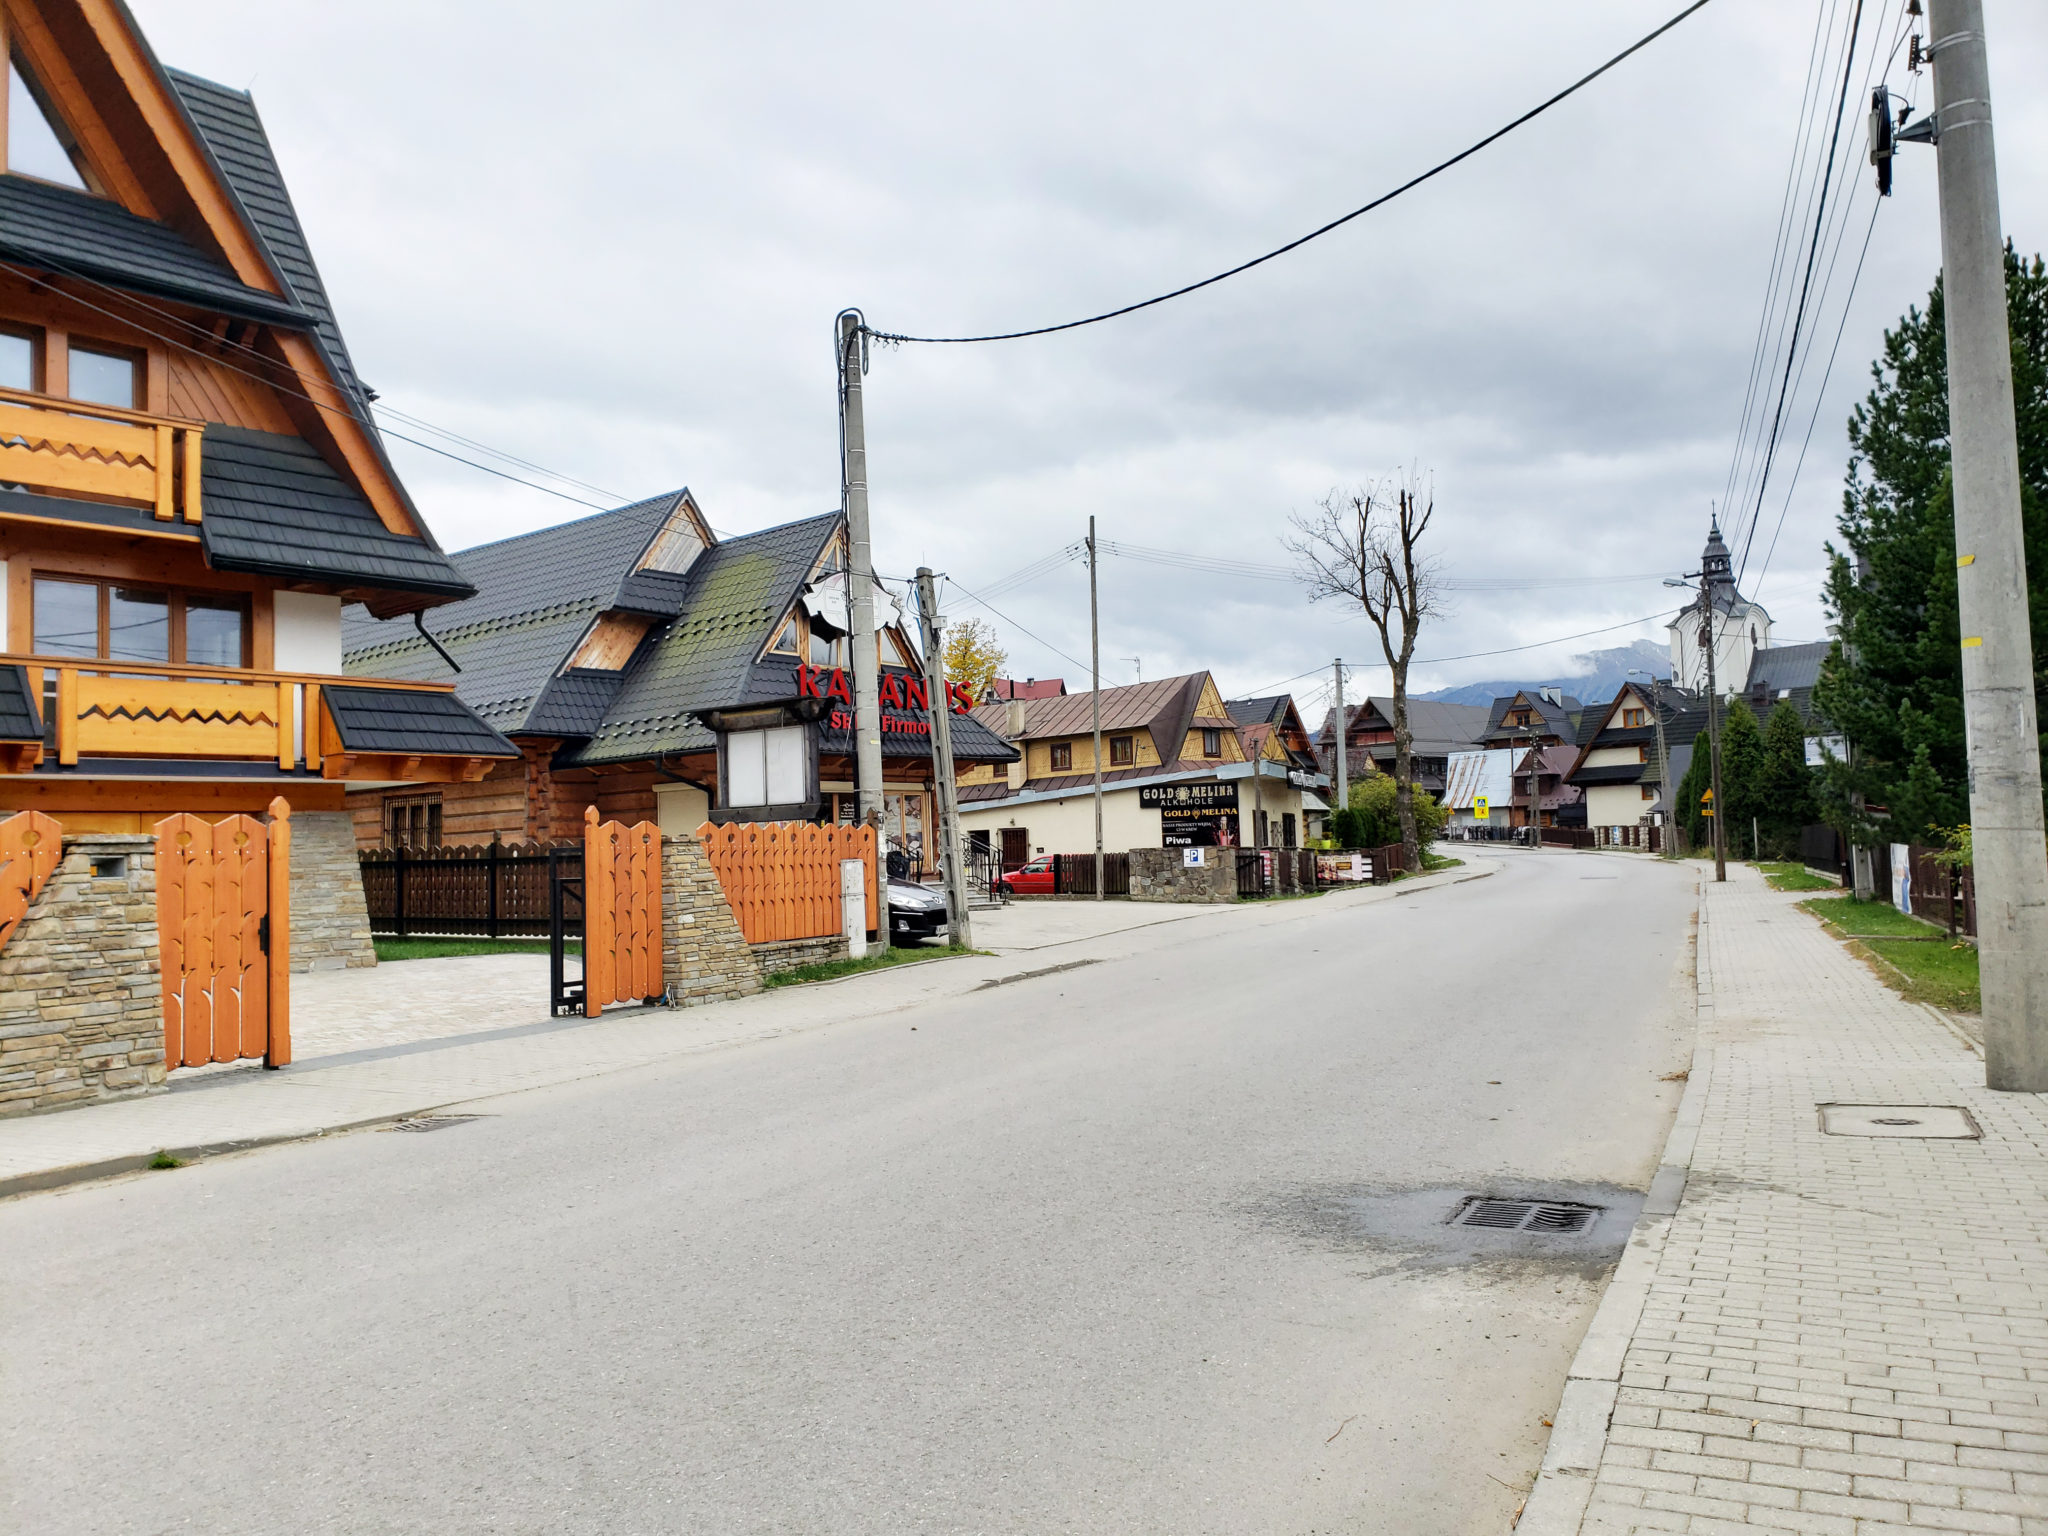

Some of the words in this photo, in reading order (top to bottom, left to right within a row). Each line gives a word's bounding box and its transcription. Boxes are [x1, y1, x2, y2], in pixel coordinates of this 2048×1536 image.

[796, 663, 973, 715] KAANS
[882, 715, 932, 735] Firmo
[1143, 787, 1174, 799] GOLD
[1191, 785, 1233, 797] MELINA
[1201, 807, 1238, 816] MELINA
[1165, 836, 1192, 845] Piwa
[1191, 850, 1197, 861] P
